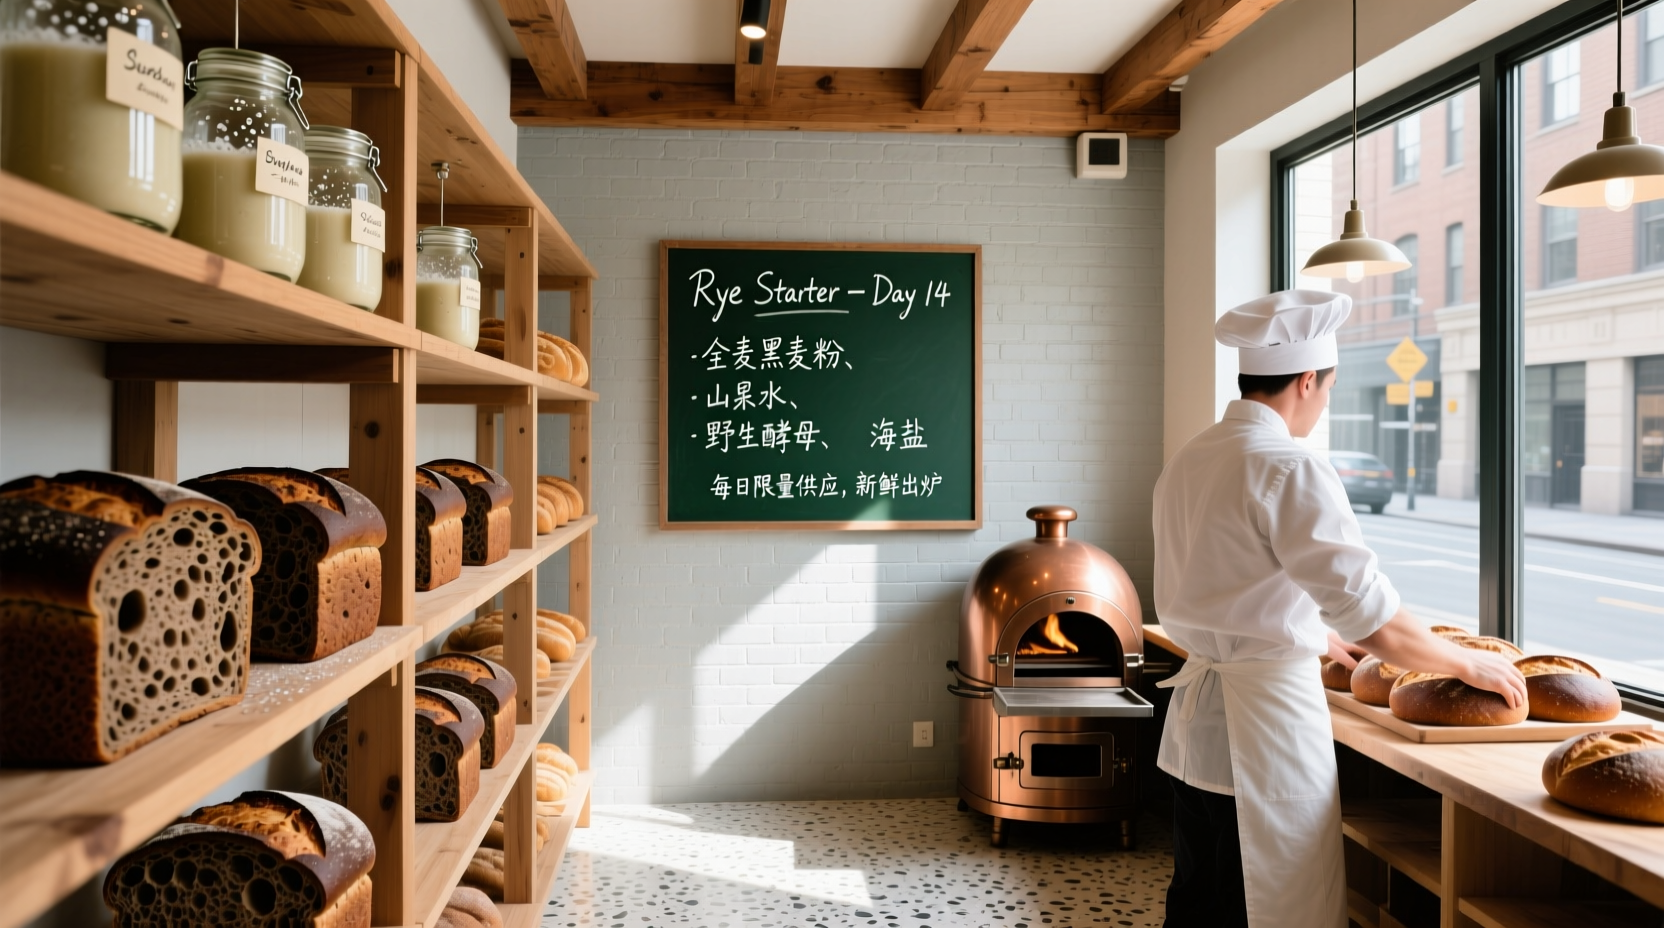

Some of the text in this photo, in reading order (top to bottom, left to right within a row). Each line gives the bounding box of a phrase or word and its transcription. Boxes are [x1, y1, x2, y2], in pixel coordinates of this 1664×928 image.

[689, 268, 743, 323] Rye
[754, 270, 841, 305] Starter
[872, 273, 917, 321] Day
[925, 280, 951, 308] 14
[870, 417, 928, 452] 海盐
